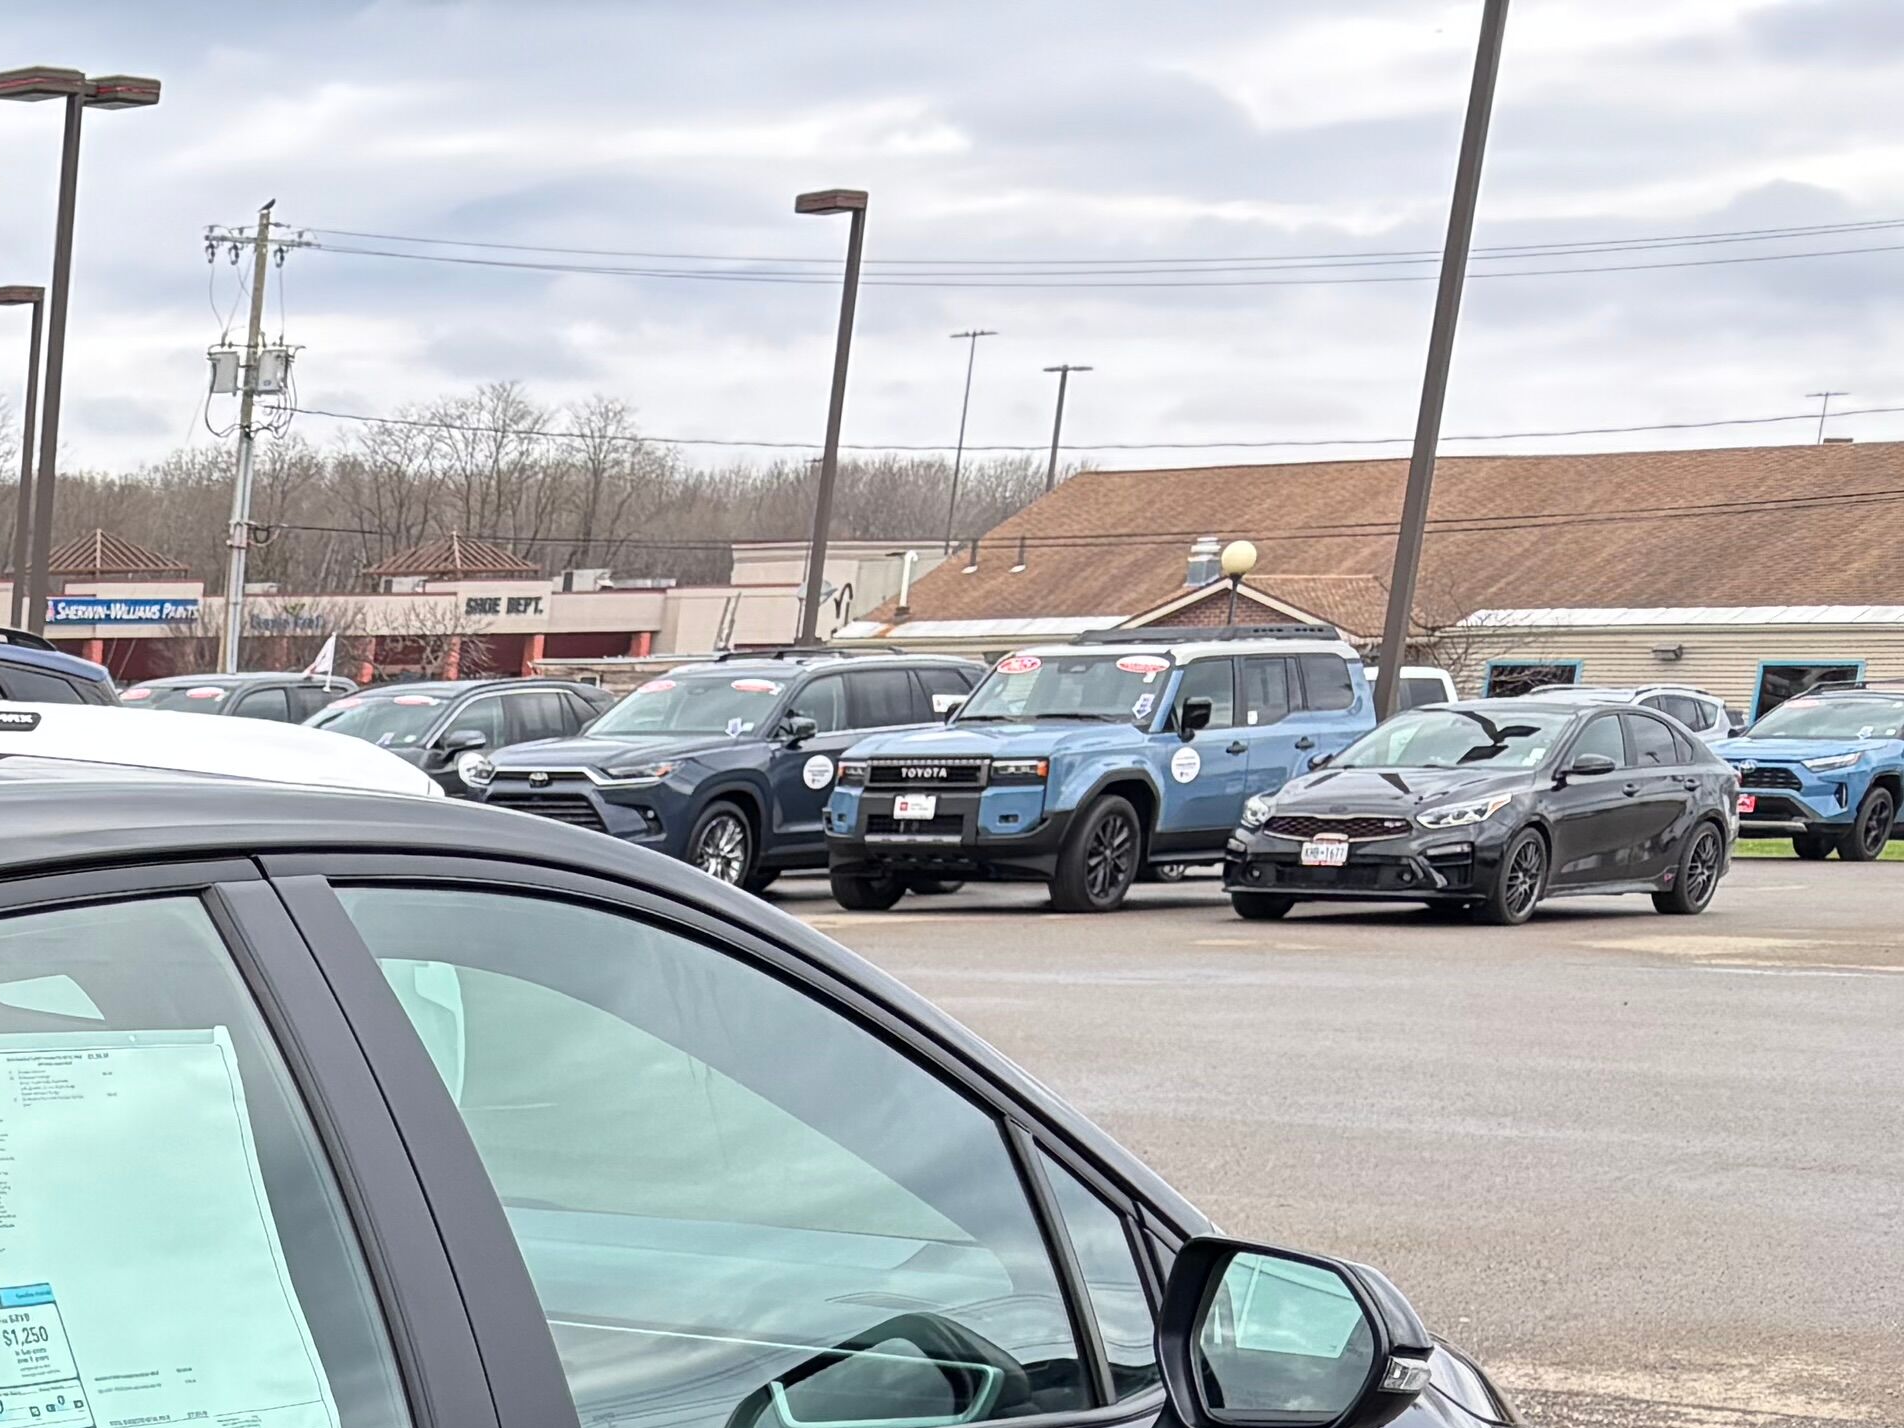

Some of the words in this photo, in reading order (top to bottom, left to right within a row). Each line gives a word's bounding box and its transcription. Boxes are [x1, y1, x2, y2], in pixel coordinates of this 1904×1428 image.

[55, 601, 161, 620] SHERWIN-WILLIAMS
[465, 597, 501, 615] SHOE
[506, 597, 543, 614] DEPT.
[901, 767, 947, 778] TOYOTA
[2, 1326, 49, 1347] $1,250
